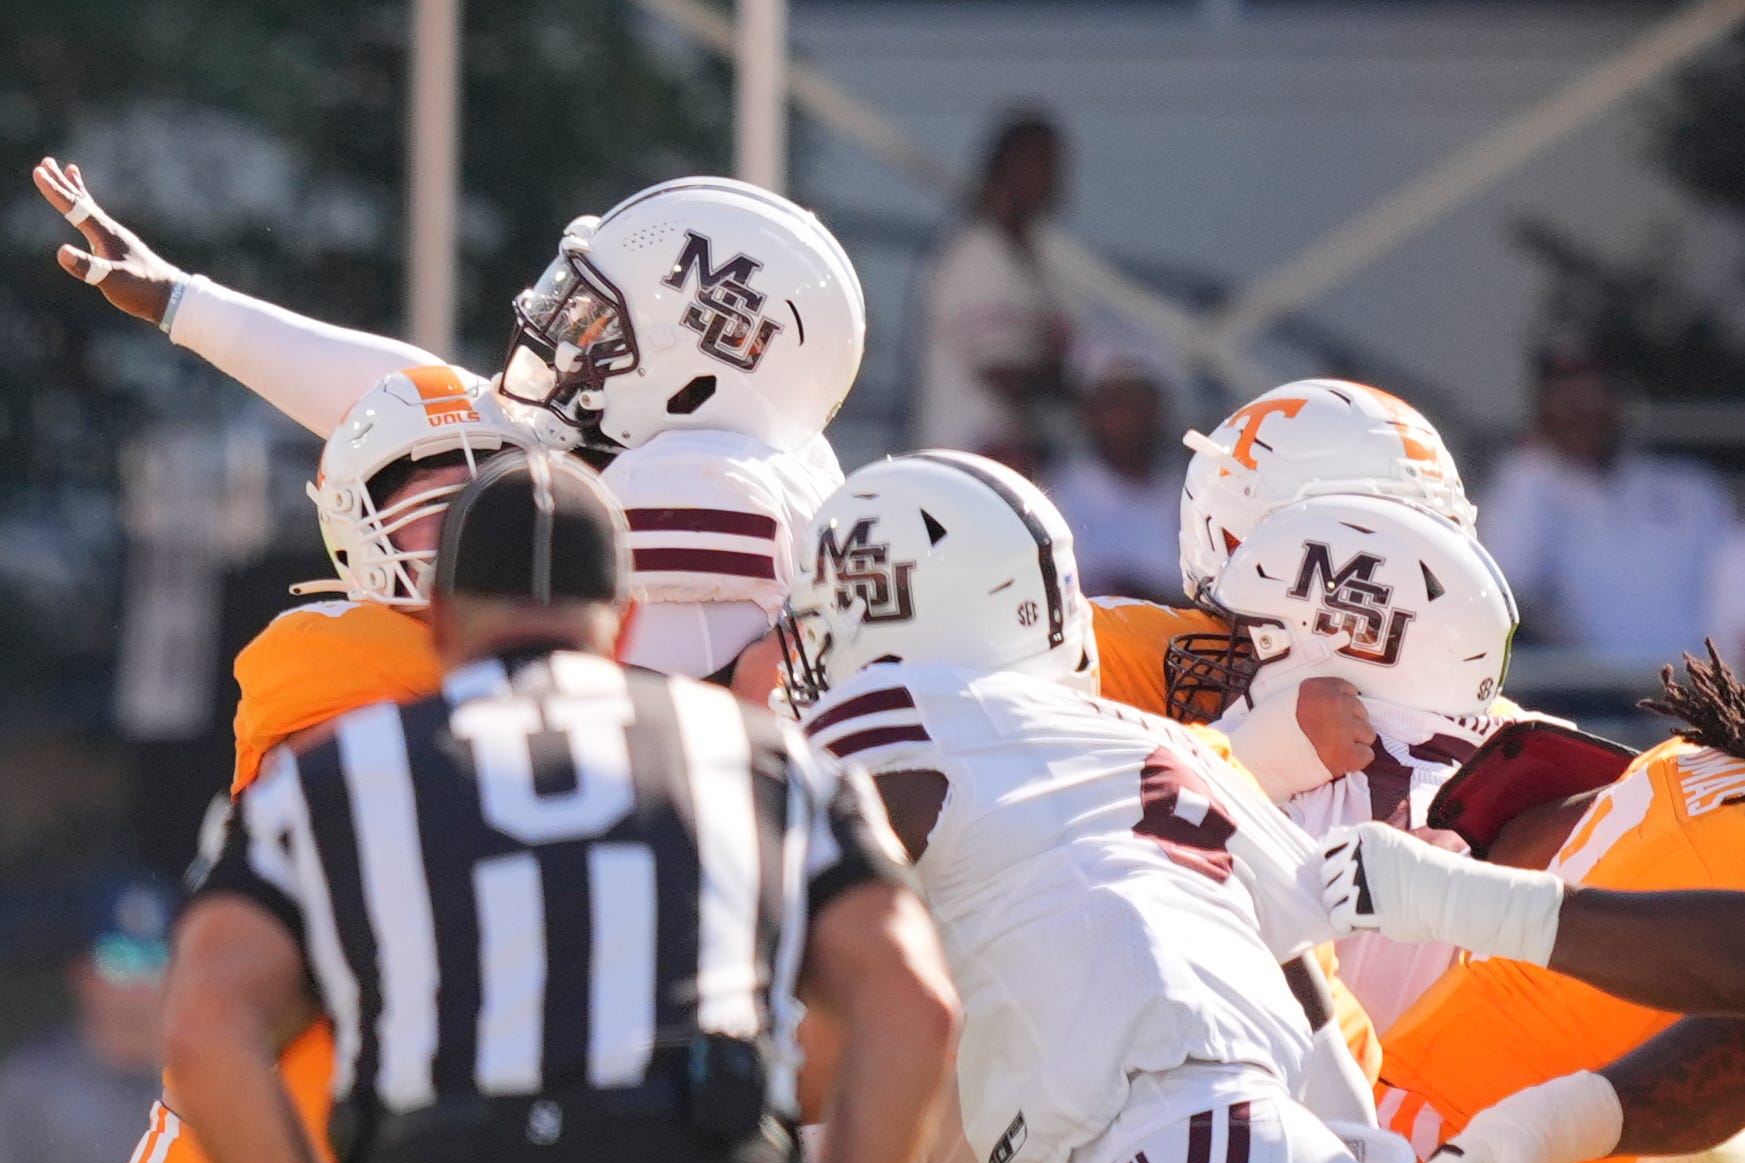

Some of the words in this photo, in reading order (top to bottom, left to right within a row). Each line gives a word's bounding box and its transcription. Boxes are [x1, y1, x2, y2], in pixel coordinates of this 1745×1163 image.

[661, 229, 784, 374] MSU
[1219, 397, 1308, 476] T
[812, 517, 917, 624] MSU
[1287, 539, 1416, 668] MSU
[449, 697, 637, 846] U
